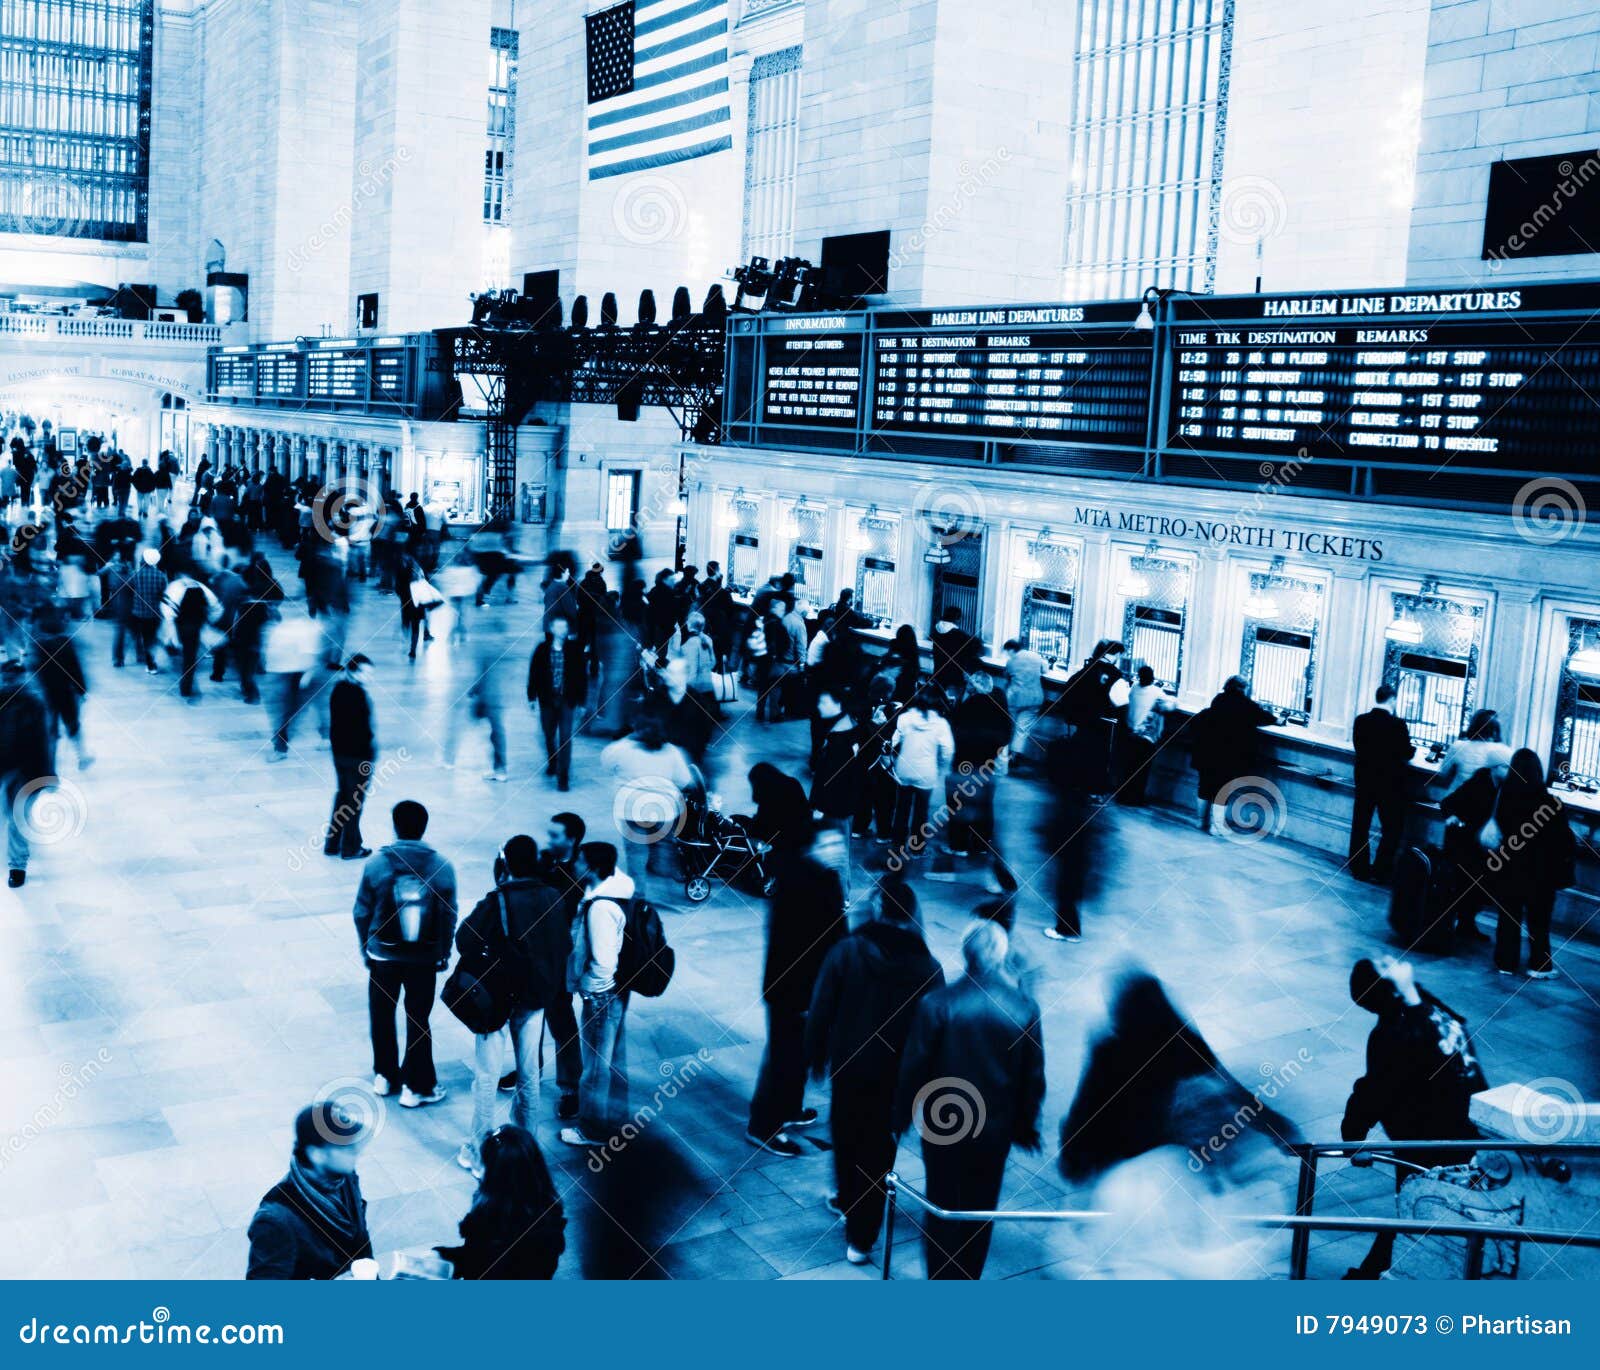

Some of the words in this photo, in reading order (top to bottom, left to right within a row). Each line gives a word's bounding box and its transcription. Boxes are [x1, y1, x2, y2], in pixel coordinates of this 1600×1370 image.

[1264, 298, 1338, 316] HARLEM
[1341, 297, 1385, 314] LINE
[1390, 291, 1521, 313] DEPARTURES
[786, 317, 846, 330] INFORMATION
[932, 312, 977, 326] HARLEM
[979, 311, 1005, 324] LINE
[1008, 308, 1084, 323] DEPARTURES
[878, 338, 896, 347] TIME
[901, 338, 918, 347] TRK
[922, 337, 976, 347] DESTINATION
[987, 336, 1030, 346] REMARKS
[1179, 333, 1207, 344] TIME
[1215, 332, 1240, 344] TRK
[1248, 331, 1336, 344] DESTINATION
[1356, 330, 1428, 343] REMARKS
[923, 353, 956, 363] SOUTHEAST
[1012, 353, 1039, 363] PLAINS
[1050, 353, 1064, 363] 1ST
[1067, 353, 1087, 363] STOP
[1181, 352, 1207, 364] 12:23
[1289, 352, 1327, 364] PLAINS
[1357, 351, 1406, 364] FORDHAM
[1427, 351, 1448, 364] 1ST
[1453, 351, 1486, 365] STOP
[63, 366, 81, 377] AVE
[111, 368, 146, 380] SUBWAY
[880, 368, 896, 377] 11:02
[947, 368, 970, 378] PLAINS
[1028, 369, 1041, 379] 1ST
[1044, 369, 1064, 380] STOP
[1179, 371, 1206, 382] 12:50
[1247, 371, 1301, 384] SOUTHEAST
[1395, 372, 1439, 386] PLAINS
[1460, 373, 1483, 386] 1ST
[1489, 373, 1523, 387] STOP
[879, 383, 896, 392] 11:23
[946, 384, 969, 393] PLAINS
[1027, 385, 1040, 396] 1ST
[1043, 385, 1062, 396] STOP
[920, 397, 953, 408] SOUTHEAST
[1030, 401, 1039, 411] TO
[1182, 388, 1204, 400] 1:02
[1220, 389, 1236, 401] 103
[1286, 390, 1324, 403] PLAINS
[1353, 392, 1402, 405] FORDHAM
[1422, 393, 1443, 407] 1ST
[1449, 394, 1481, 408] STOP
[944, 413, 967, 424] PLAINS
[1025, 417, 1038, 428] 1ST
[1040, 417, 1060, 429] STOP
[1181, 406, 1203, 418] 1:23
[1284, 410, 1322, 423] PLAINS
[1420, 414, 1441, 428] 1ST
[1447, 415, 1479, 429] STOP
[1180, 424, 1201, 436] 1:50
[1216, 425, 1233, 438] 112
[1242, 427, 1296, 441] SOUTHEAST
[1349, 432, 1419, 448] CONNECTION
[1424, 435, 1439, 449] TO
[1074, 507, 1112, 529] MTA
[1118, 513, 1275, 549] METRO-NORTH
[1282, 530, 1384, 562] TICKETS
